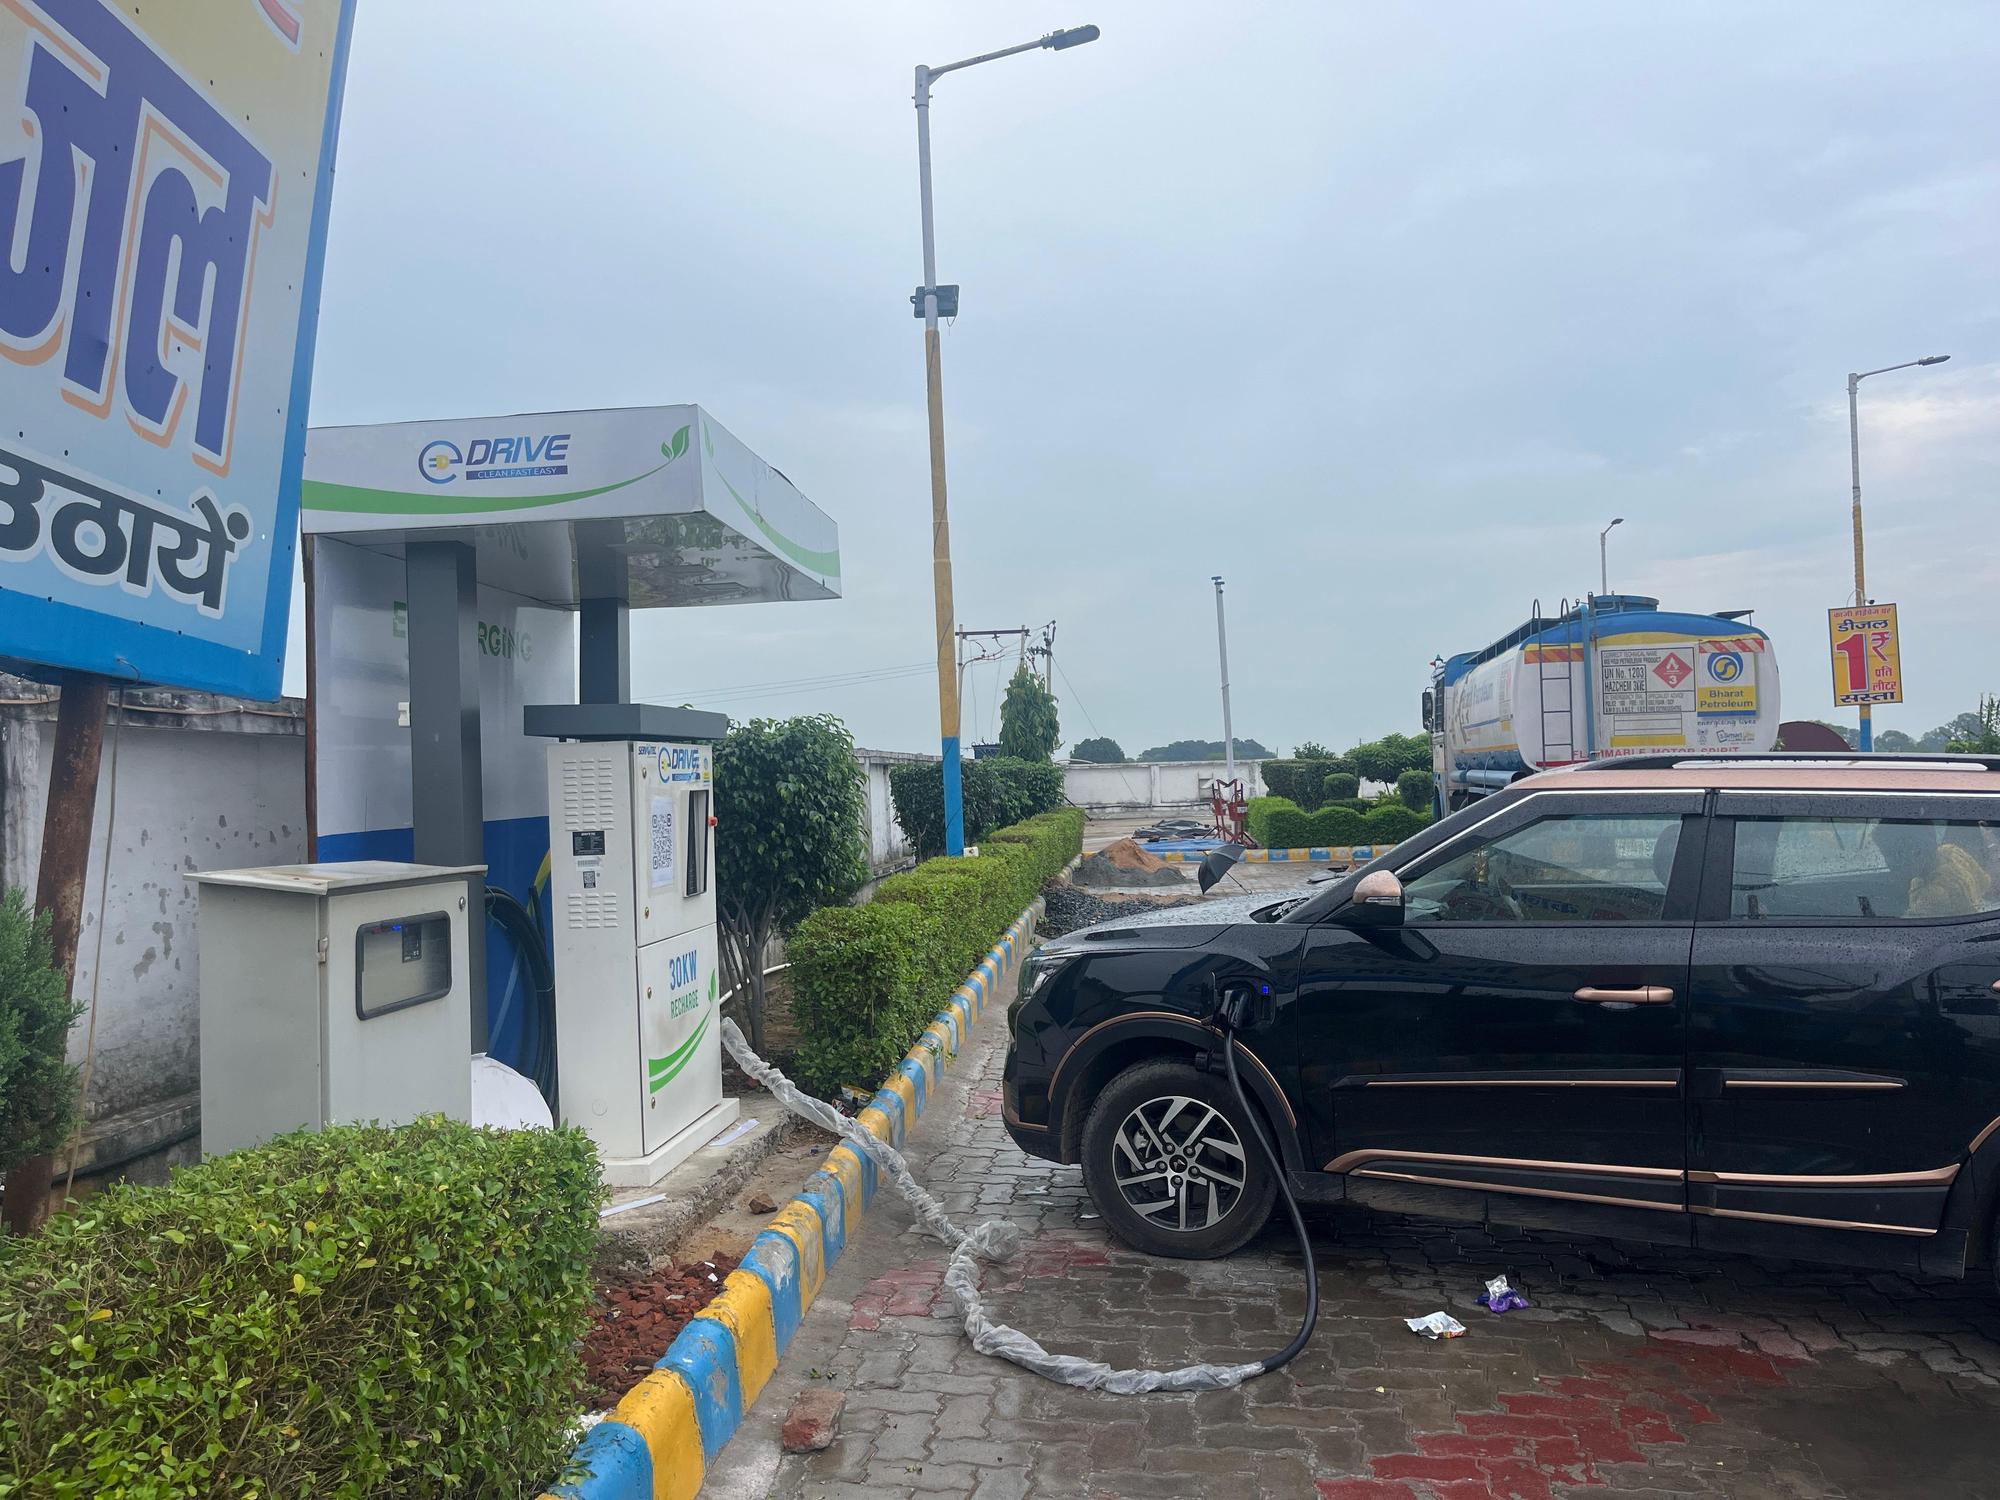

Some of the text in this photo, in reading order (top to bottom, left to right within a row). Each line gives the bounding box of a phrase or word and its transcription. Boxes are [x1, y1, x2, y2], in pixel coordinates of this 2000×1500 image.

[466, 434, 571, 466] DRIVE
[1837, 618, 1889, 632] डीजल
[1836, 633, 1868, 692] 1
[1604, 668, 1614, 679] UN
[1629, 667, 1645, 678] 1203
[1668, 675, 1677, 684] 3
[1872, 680, 1896, 691] लीटर
[1605, 681, 1631, 692] HAZCHEM
[1709, 690, 1744, 698] Bharat
[1839, 692, 1896, 703] सस्ता
[1700, 700, 1753, 708] Petroleum
[672, 749, 699, 770] DRIVE
[669, 950, 697, 991] 30KW
[670, 989, 698, 1019] RECHARGE
